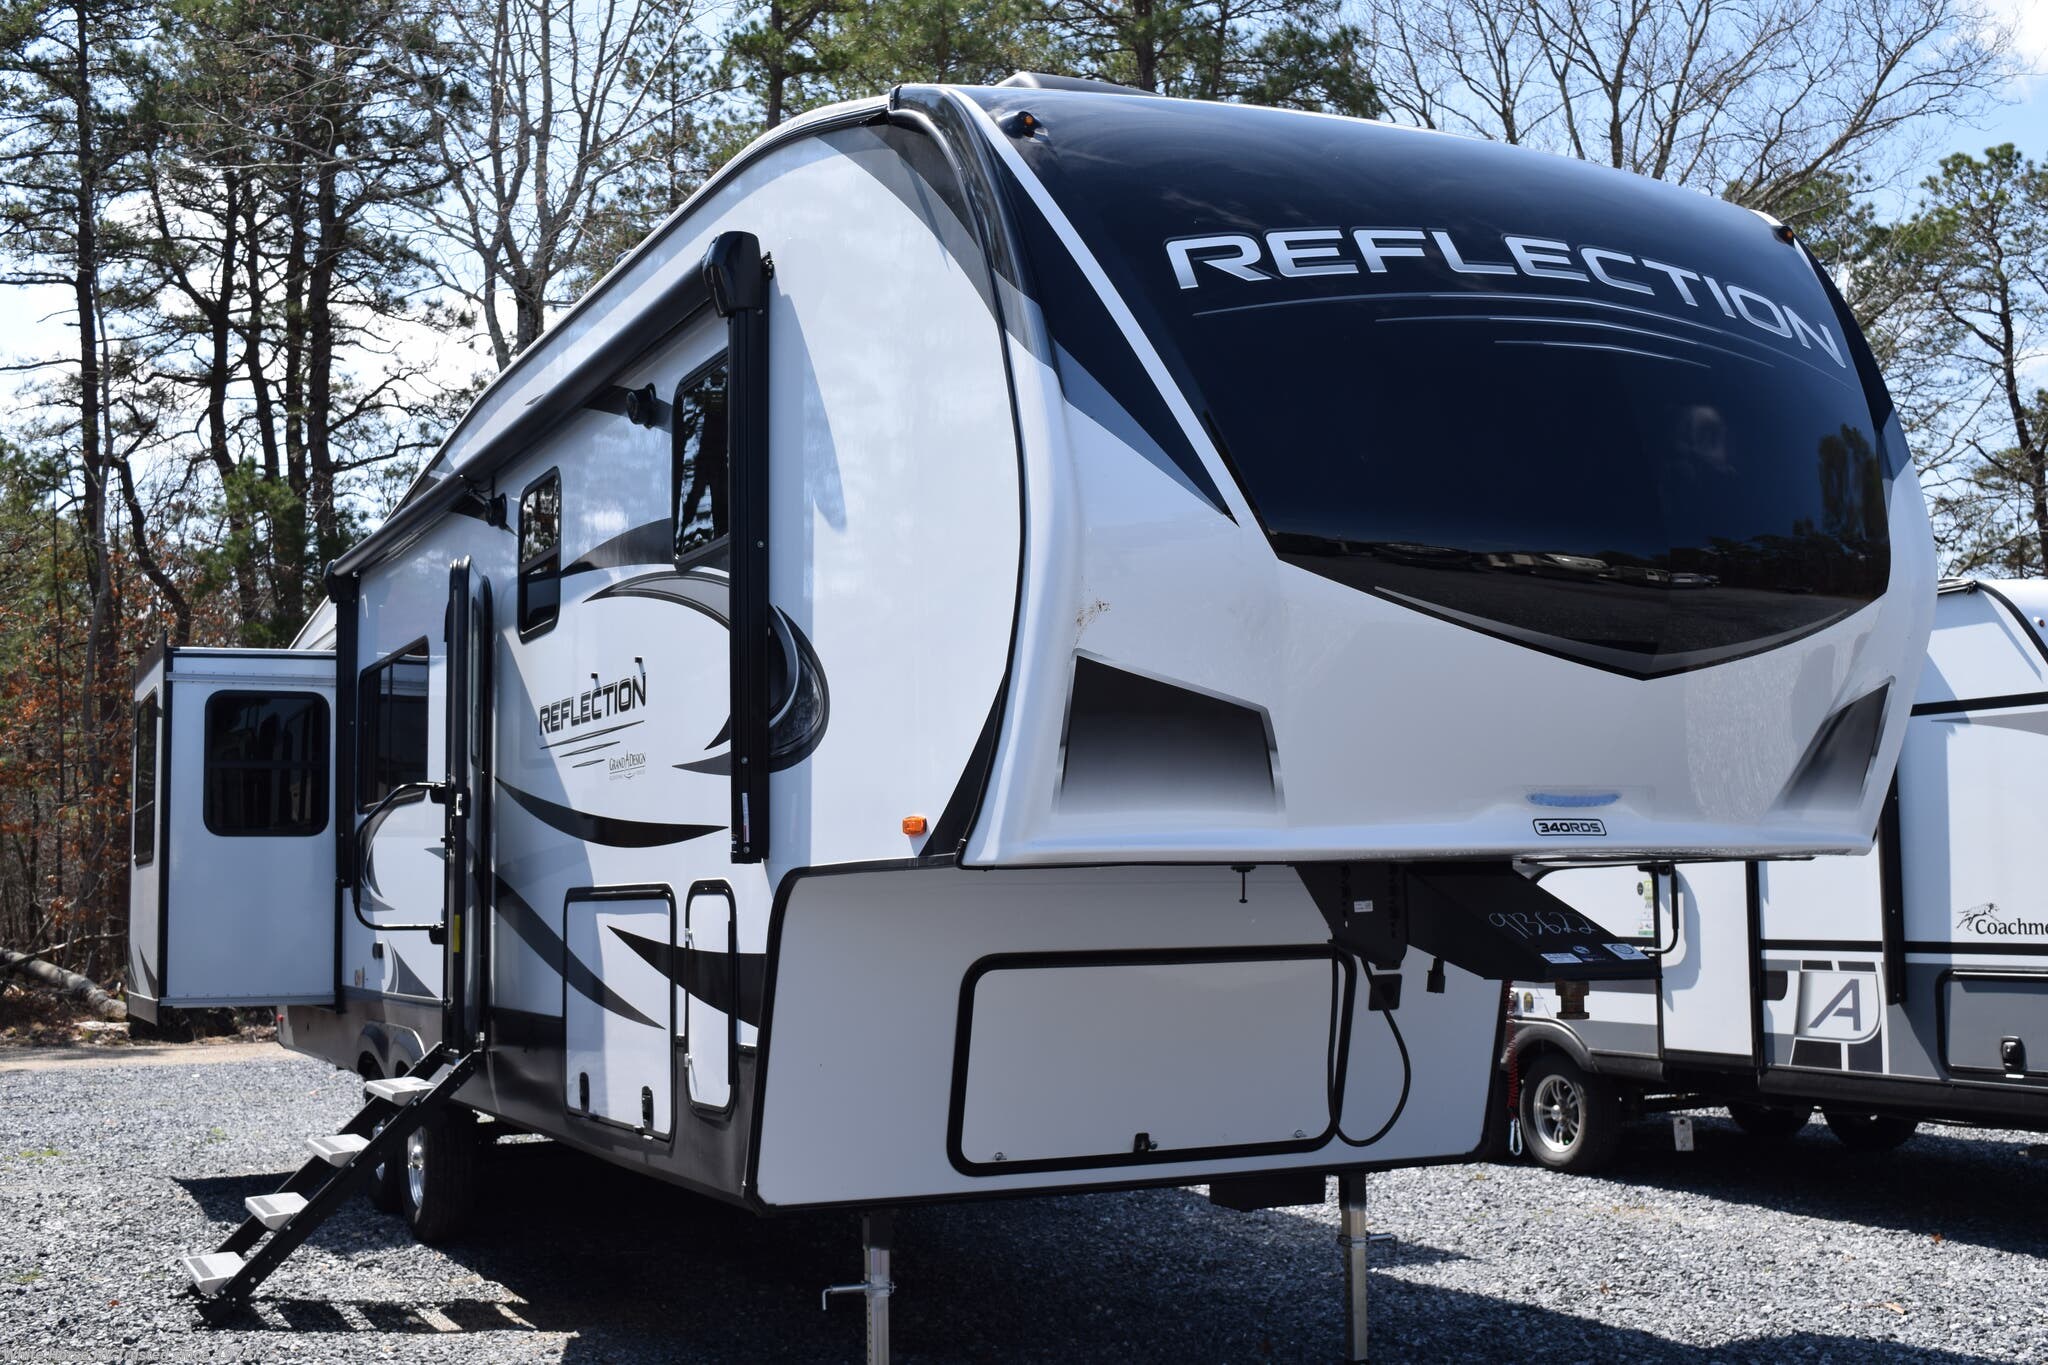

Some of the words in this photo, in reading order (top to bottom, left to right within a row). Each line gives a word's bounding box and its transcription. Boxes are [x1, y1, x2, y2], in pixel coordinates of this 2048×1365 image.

[1165, 227, 1846, 368] REFLECTION
[540, 673, 646, 736] REFLECTION
[1538, 822, 1601, 833] 340RDS
